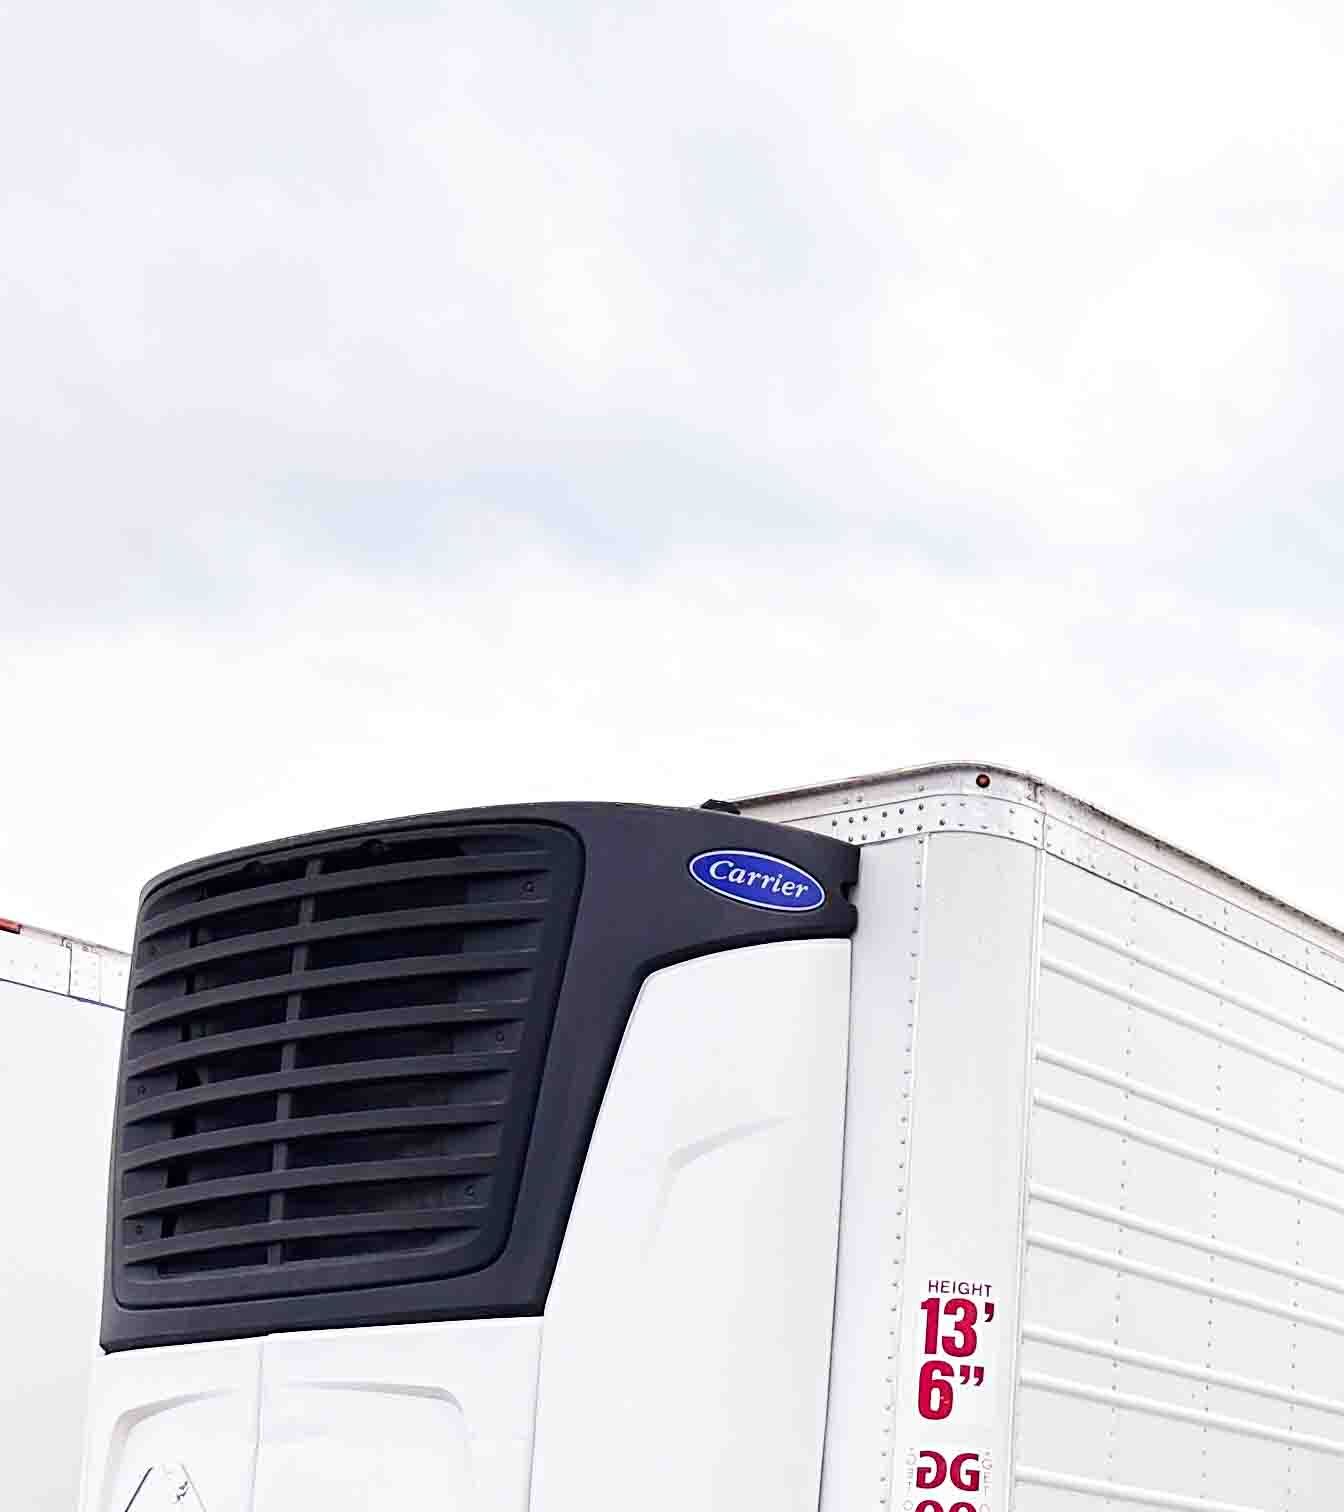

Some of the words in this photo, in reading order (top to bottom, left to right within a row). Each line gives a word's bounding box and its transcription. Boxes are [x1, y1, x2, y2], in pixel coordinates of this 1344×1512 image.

[708, 859, 809, 898] Carrier
[928, 1280, 993, 1297] HEIGHT
[920, 1298, 995, 1358] 13'
